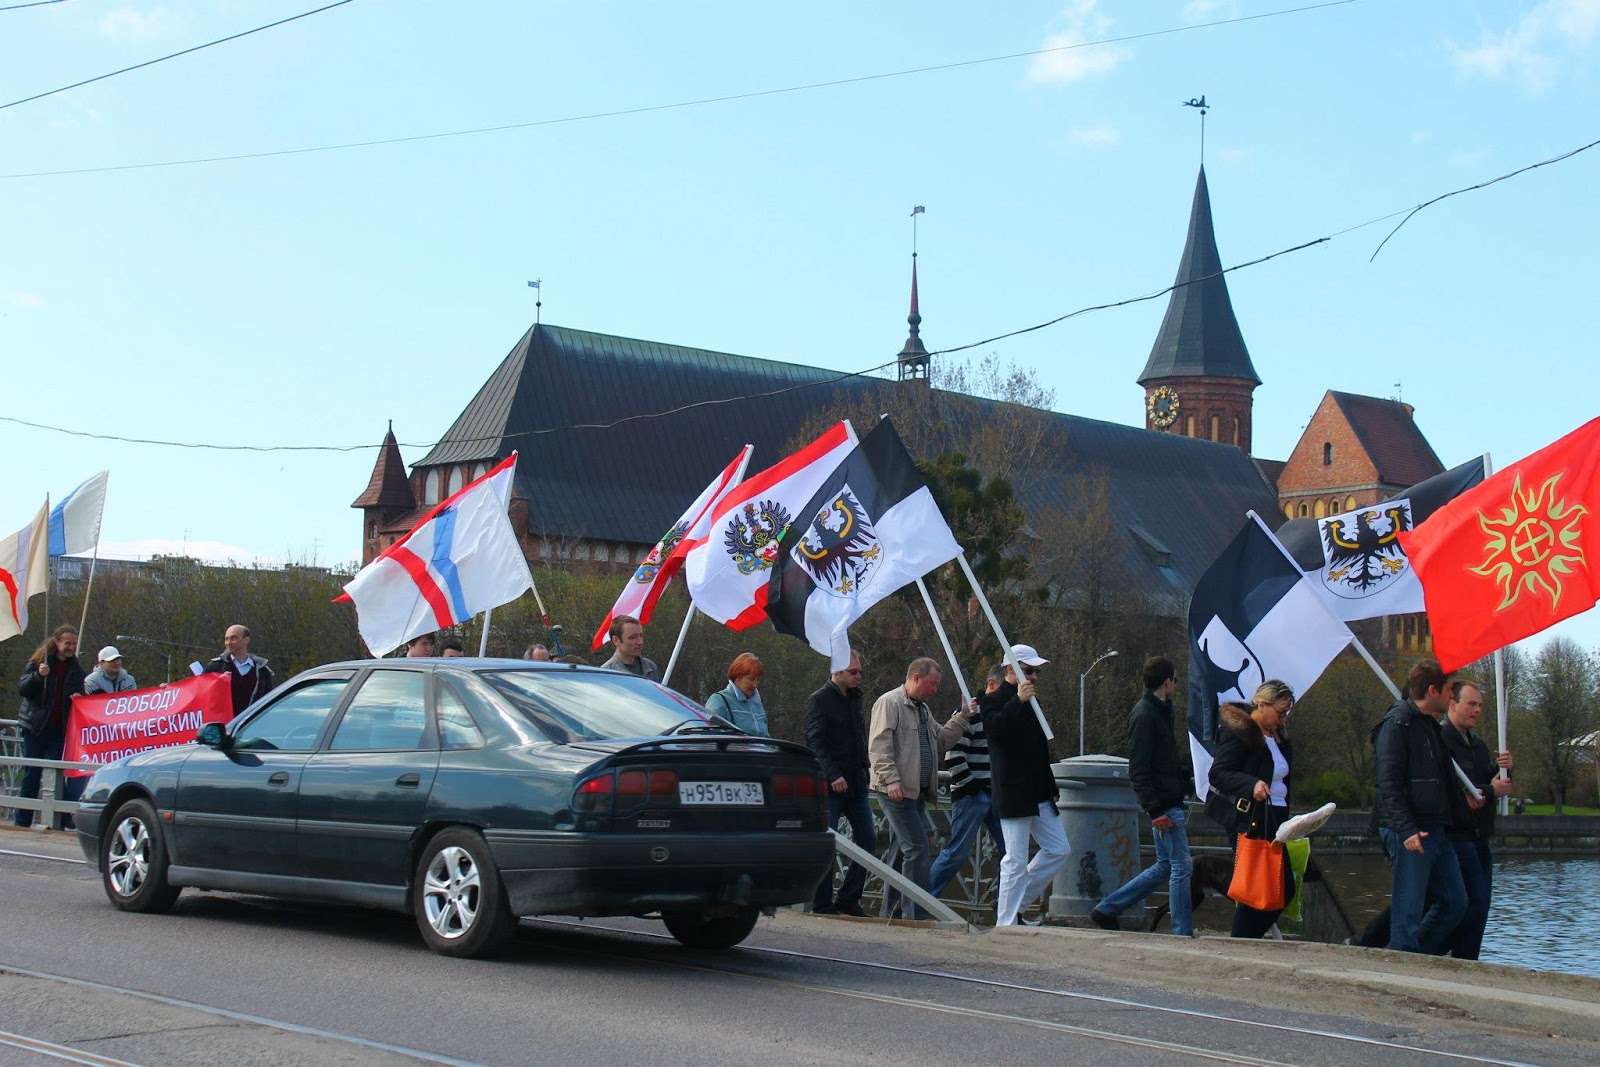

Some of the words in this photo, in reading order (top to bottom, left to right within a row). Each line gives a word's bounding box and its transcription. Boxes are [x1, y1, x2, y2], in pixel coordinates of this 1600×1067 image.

[105, 688, 180, 716] СВОБОДУ
[81, 710, 203, 746] ПОЛИТИЧЕСКИМ
[744, 784, 758, 797] 39
